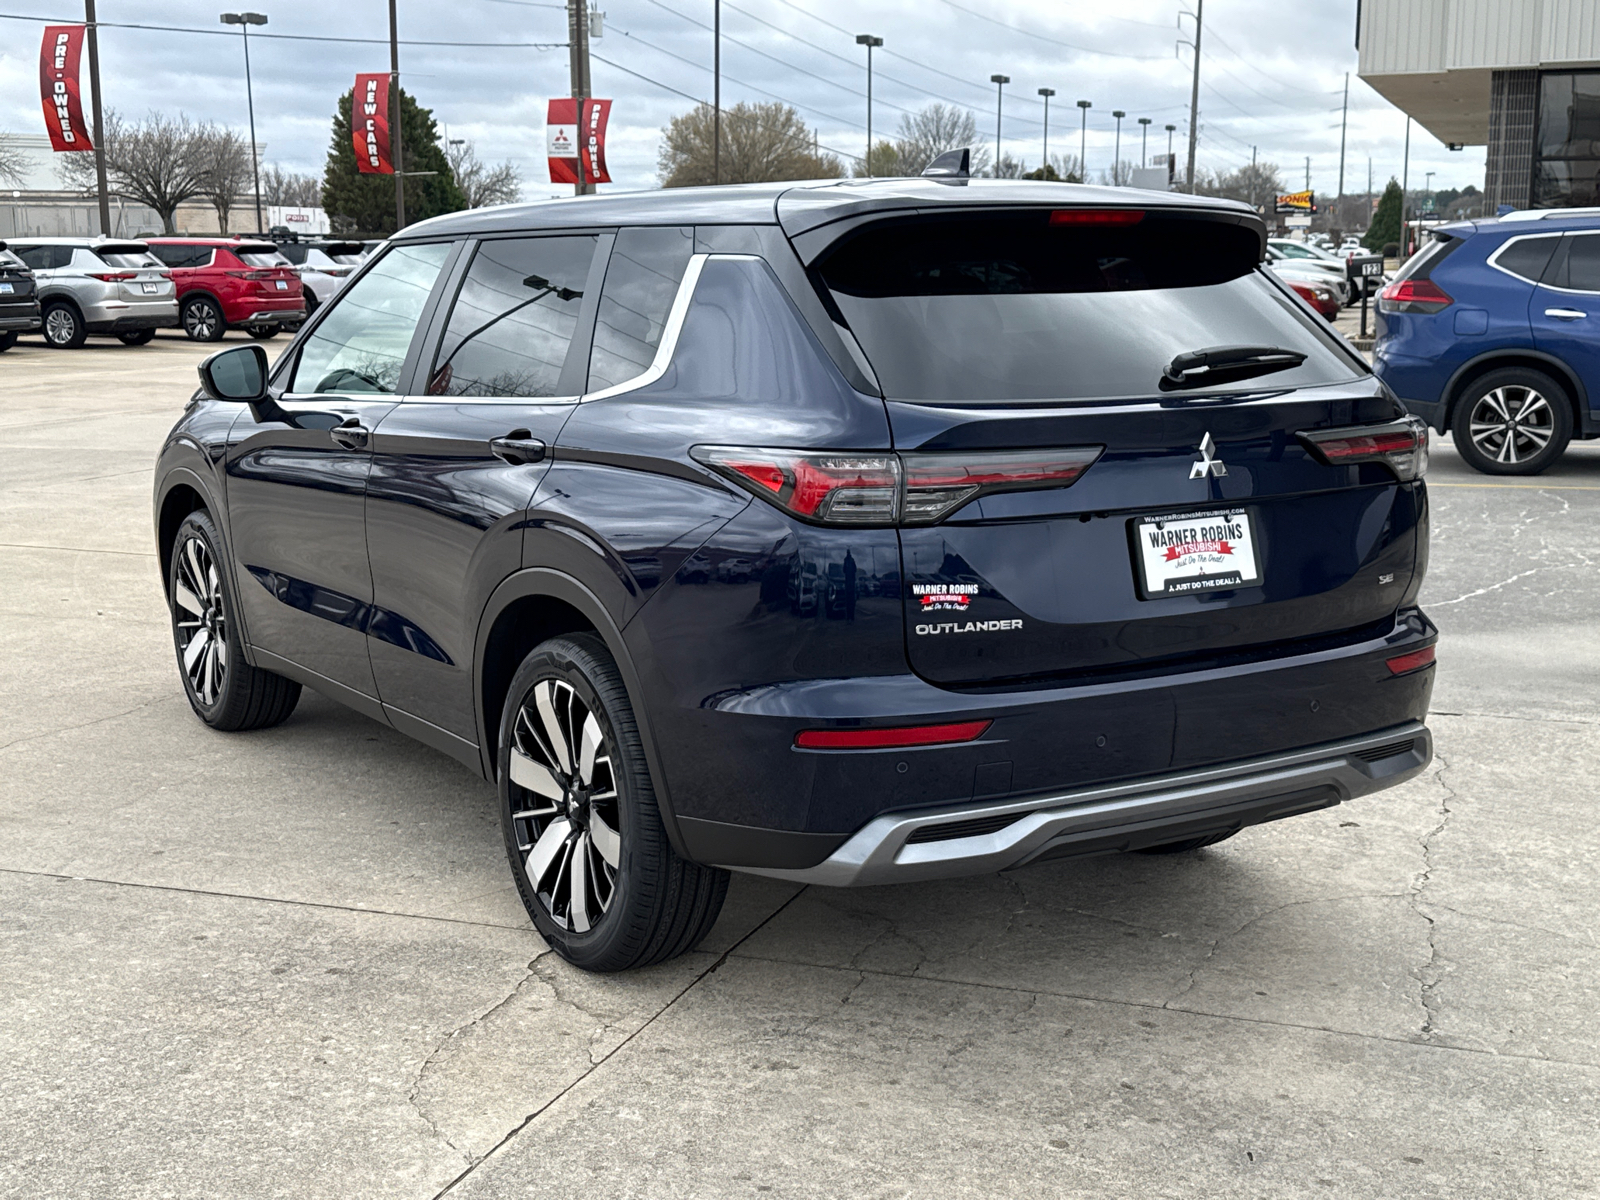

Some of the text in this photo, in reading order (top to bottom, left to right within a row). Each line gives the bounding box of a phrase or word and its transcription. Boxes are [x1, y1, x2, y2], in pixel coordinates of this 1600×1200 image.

[364, 80, 380, 168] NEW CARS
[1278, 194, 1310, 204] SONIC
[1363, 264, 1381, 275] 123
[1149, 523, 1243, 548] WARNER ROBINS
[1174, 542, 1222, 556] MITSUBISHI
[1175, 558, 1188, 569] Just
[1188, 556, 1197, 564] Do
[1197, 554, 1207, 563] The
[912, 584, 979, 595] WARNER ROBINS
[1175, 583, 1192, 591] JUST
[1202, 580, 1216, 588] THE
[1215, 577, 1235, 586] DEAL!
[915, 619, 1023, 636] OUTLANDER
[591, 695, 623, 779] NEXEN
